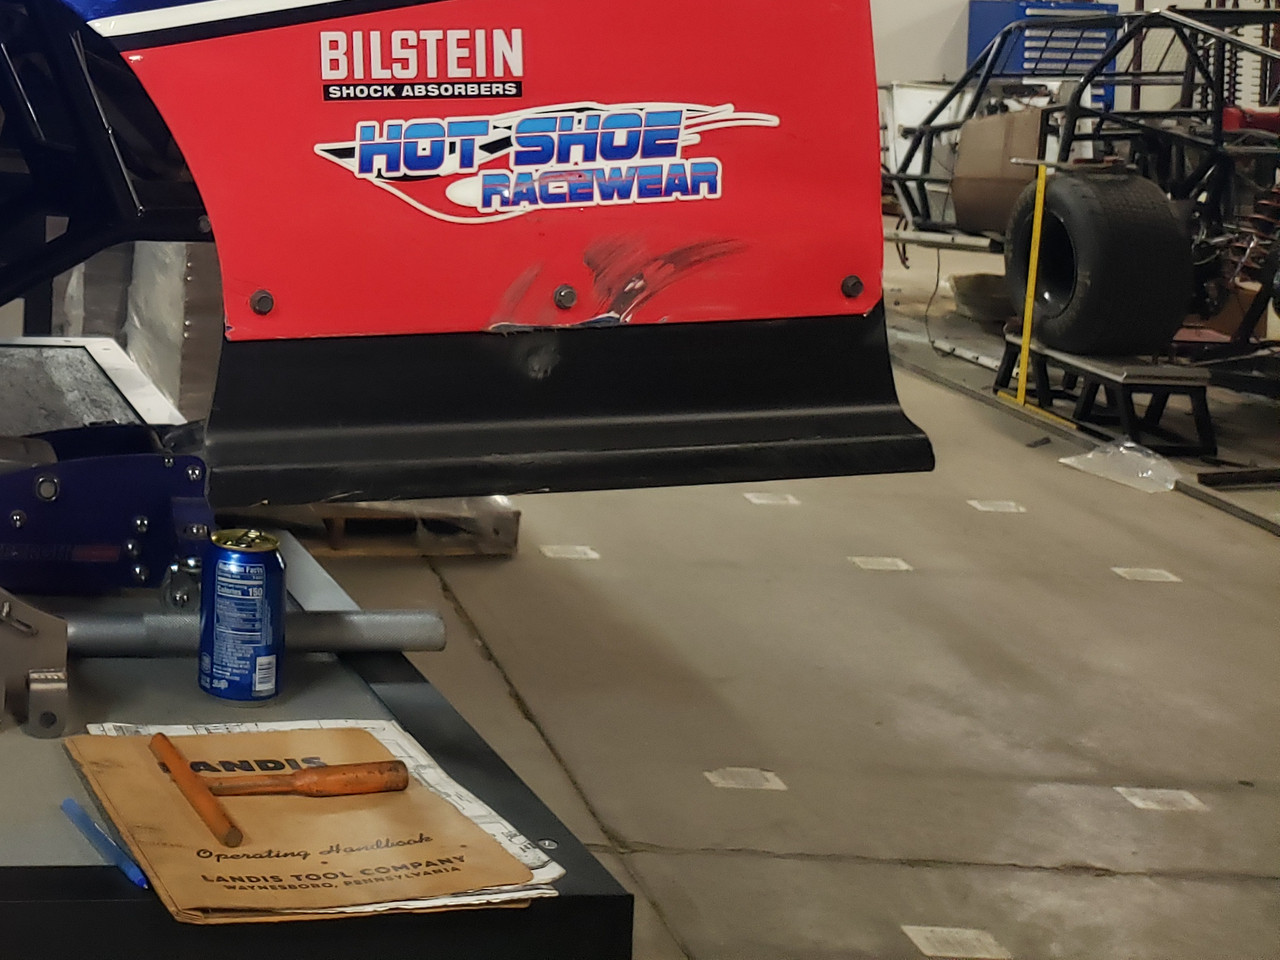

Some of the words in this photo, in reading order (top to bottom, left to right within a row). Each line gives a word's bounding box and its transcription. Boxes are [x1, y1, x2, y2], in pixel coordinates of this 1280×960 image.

[320, 28, 524, 81] BILSTEIN
[328, 84, 396, 98] SHOCK
[401, 82, 518, 97] ABSORBERS
[356, 119, 489, 175] HOT
[513, 109, 685, 166] SHOE
[480, 160, 720, 209] RACEWEAR
[158, 756, 328, 773] ANDIS
[196, 848, 311, 862] Operating
[318, 833, 434, 856] Handbook
[200, 874, 283, 883] LANDIS
[290, 871, 353, 881] TOOL
[359, 855, 466, 876] COMPANY
[343, 865, 462, 887] PENNSYLVANIA
